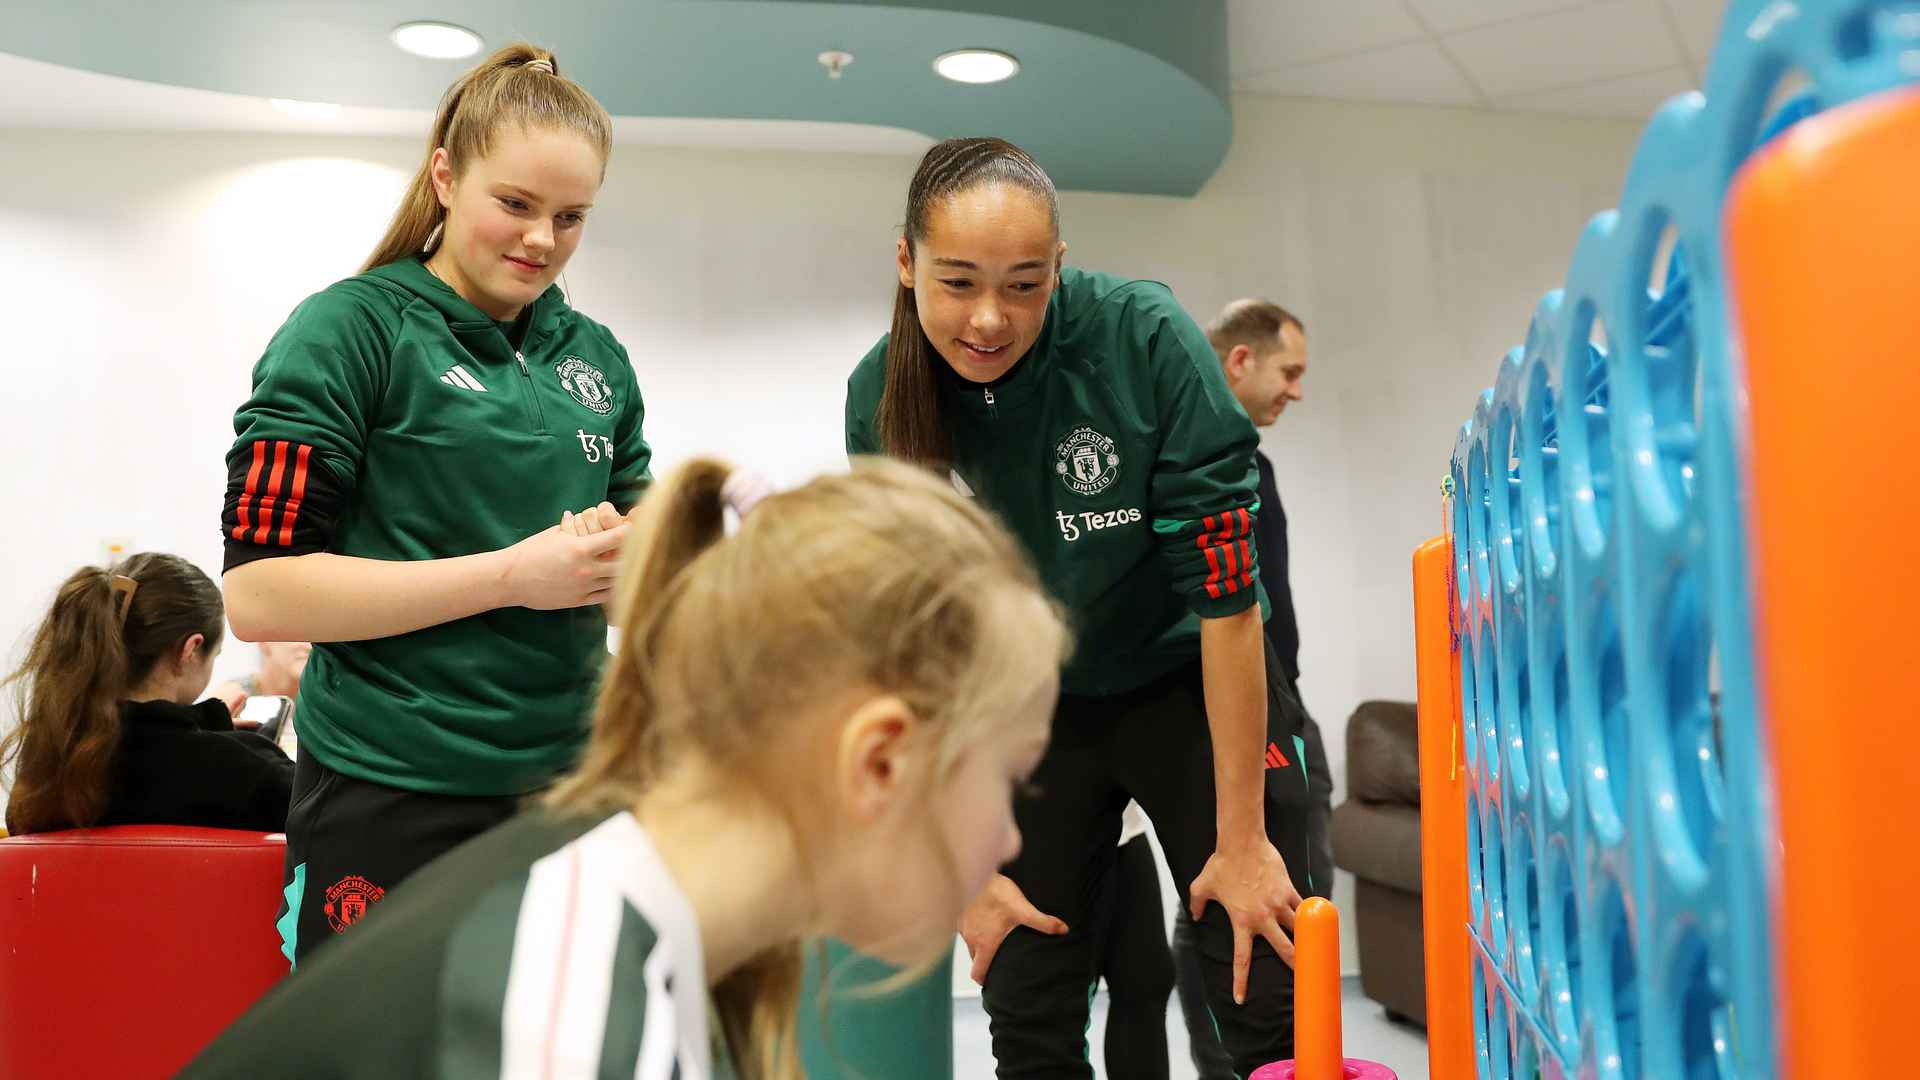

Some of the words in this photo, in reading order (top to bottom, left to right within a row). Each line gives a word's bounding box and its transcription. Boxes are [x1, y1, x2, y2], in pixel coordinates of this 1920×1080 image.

[1061, 432, 1110, 457] MANCHESTER
[1073, 476, 1110, 491] UNITED
[1079, 508, 1142, 531] Tezos
